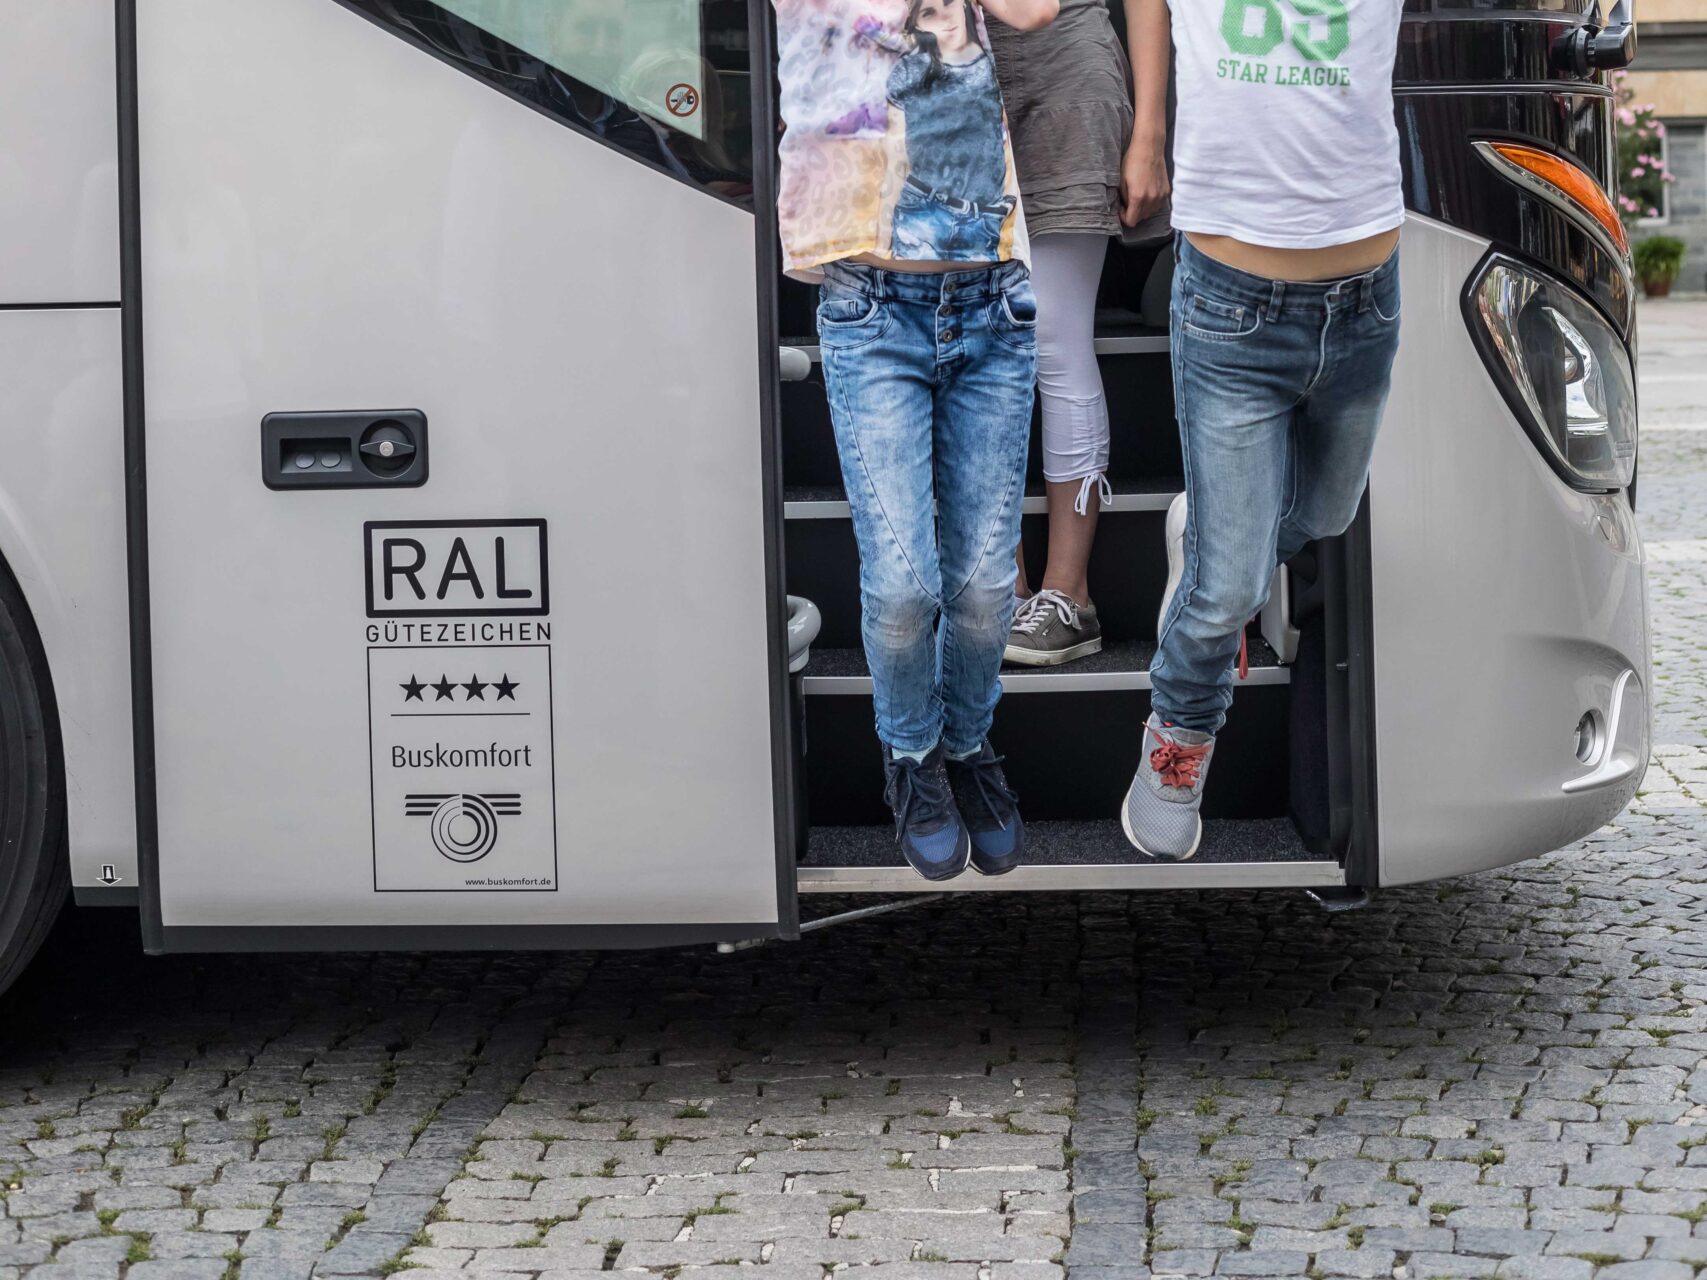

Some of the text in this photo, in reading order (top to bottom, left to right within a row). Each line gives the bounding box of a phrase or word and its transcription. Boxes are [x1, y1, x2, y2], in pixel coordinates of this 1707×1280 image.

[1216, 58, 1352, 86] STAR LEAGUE
[383, 536, 532, 600] RAL
[365, 620, 551, 643] GÜTEZEICHEN
[391, 742, 532, 768] Buskomfort
[465, 877, 552, 886] www.buskomfort.de
